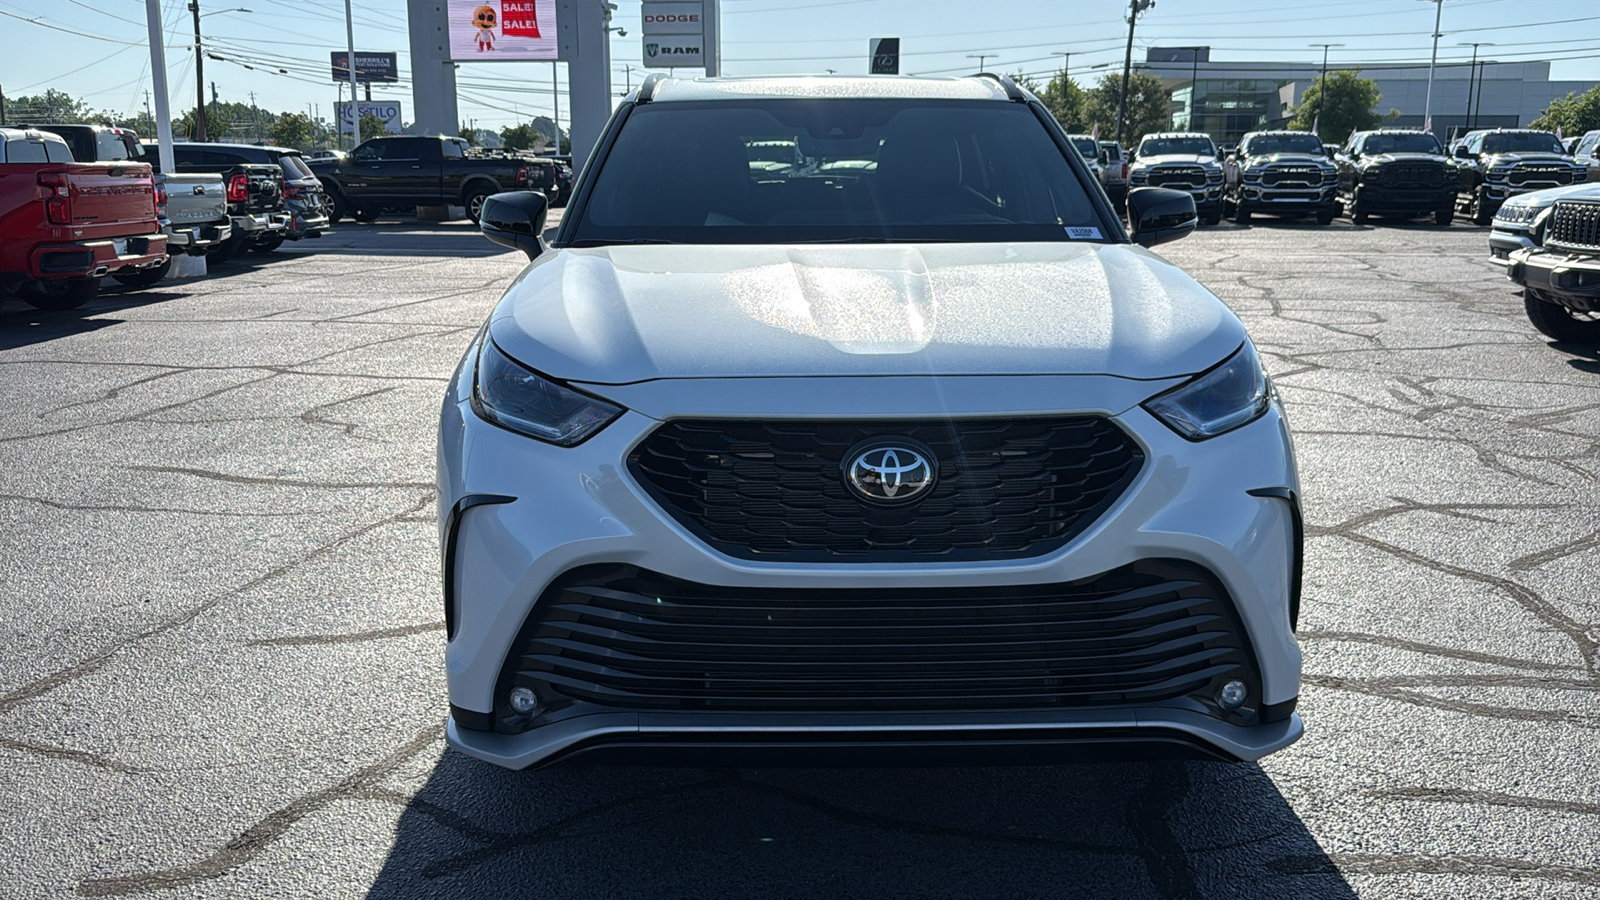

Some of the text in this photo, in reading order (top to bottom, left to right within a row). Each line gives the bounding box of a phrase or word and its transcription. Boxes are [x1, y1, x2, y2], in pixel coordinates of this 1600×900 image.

[503, 3, 534, 12] SALE!
[644, 14, 699, 23] DODGE
[503, 20, 537, 29] SALE!
[79, 185, 152, 197] CHEVROLET
